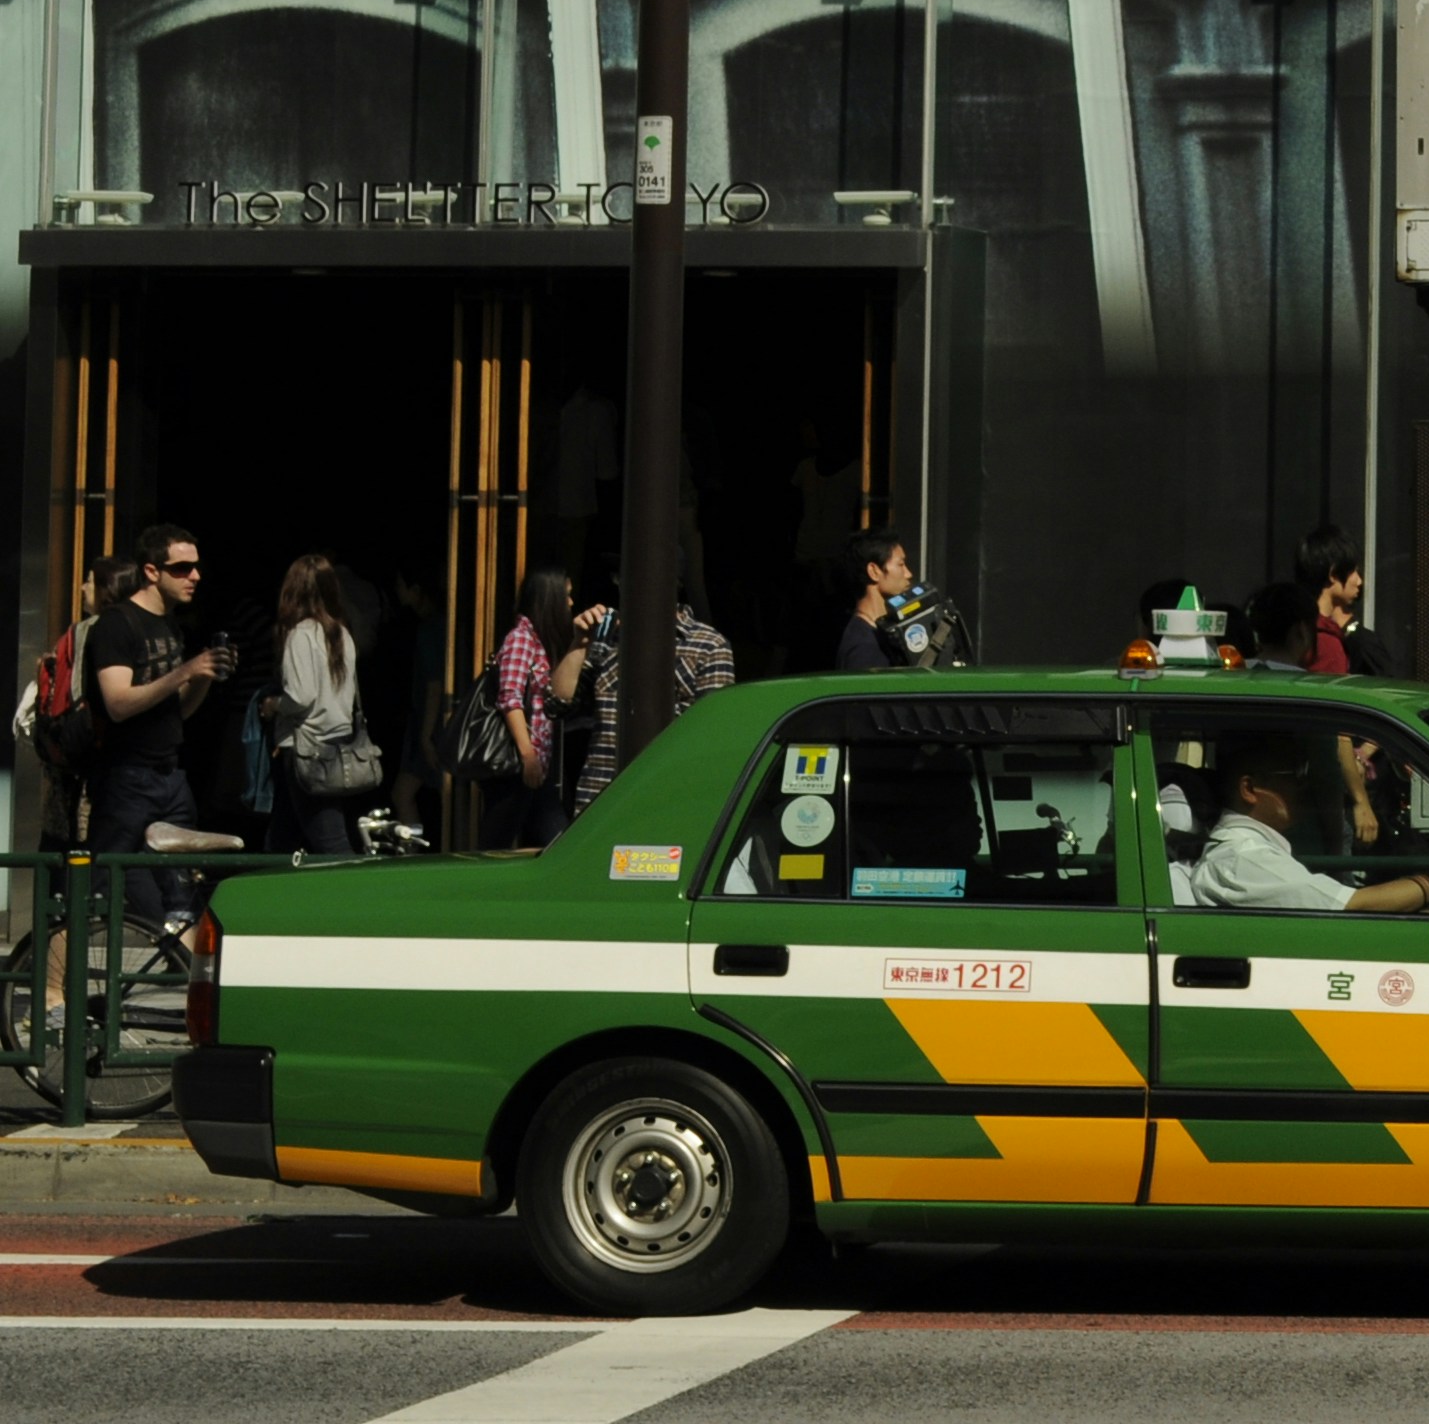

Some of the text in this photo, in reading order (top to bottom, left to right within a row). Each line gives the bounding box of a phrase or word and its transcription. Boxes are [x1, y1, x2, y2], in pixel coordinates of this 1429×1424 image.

[638, 176, 666, 187] 0141
[179, 180, 283, 224] The
[577, 181, 769, 225] TOYO
[890, 963, 1026, 989] 東京無線 1212
[1327, 971, 1355, 1001] 宮
